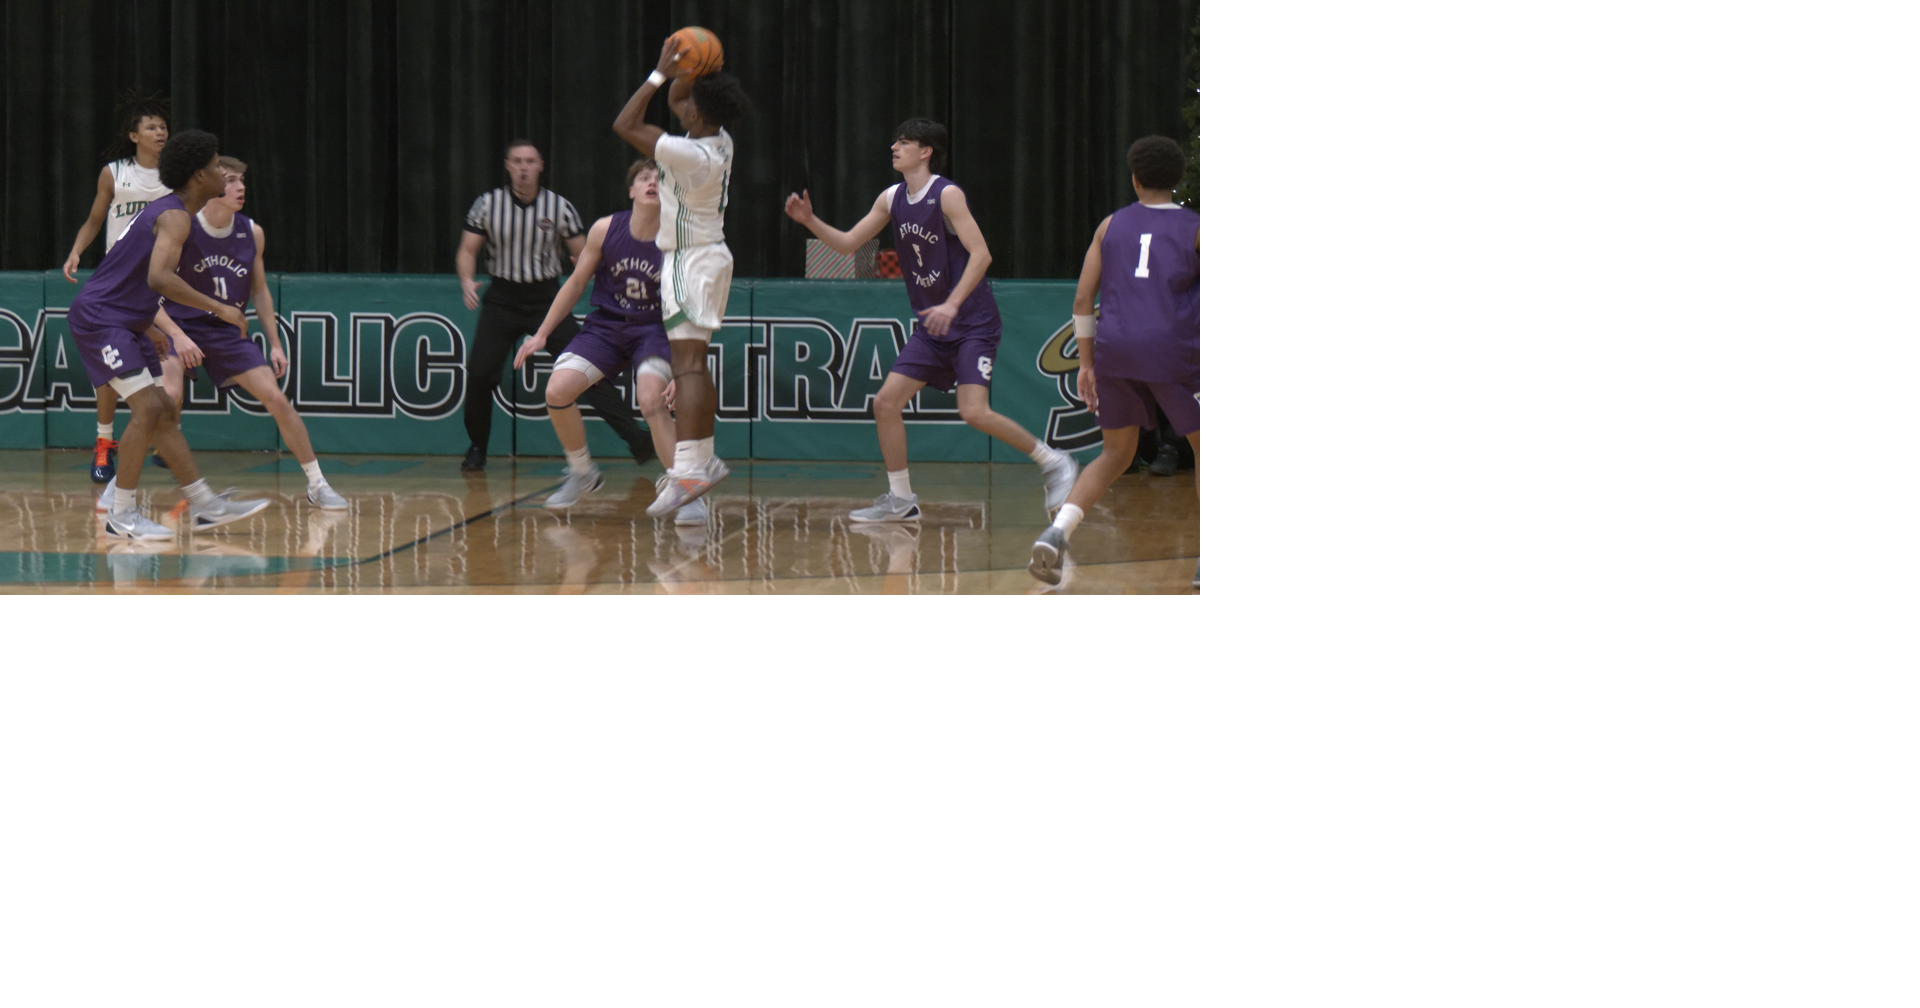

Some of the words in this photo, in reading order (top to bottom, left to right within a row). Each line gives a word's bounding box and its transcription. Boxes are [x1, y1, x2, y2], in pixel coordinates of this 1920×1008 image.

[115, 201, 153, 219] LUD
[899, 222, 939, 244] ATHOLIC
[193, 255, 248, 278] CATHOLIC
[1134, 233, 1152, 279] 1
[212, 276, 229, 301] 11
[626, 277, 649, 300] 21
